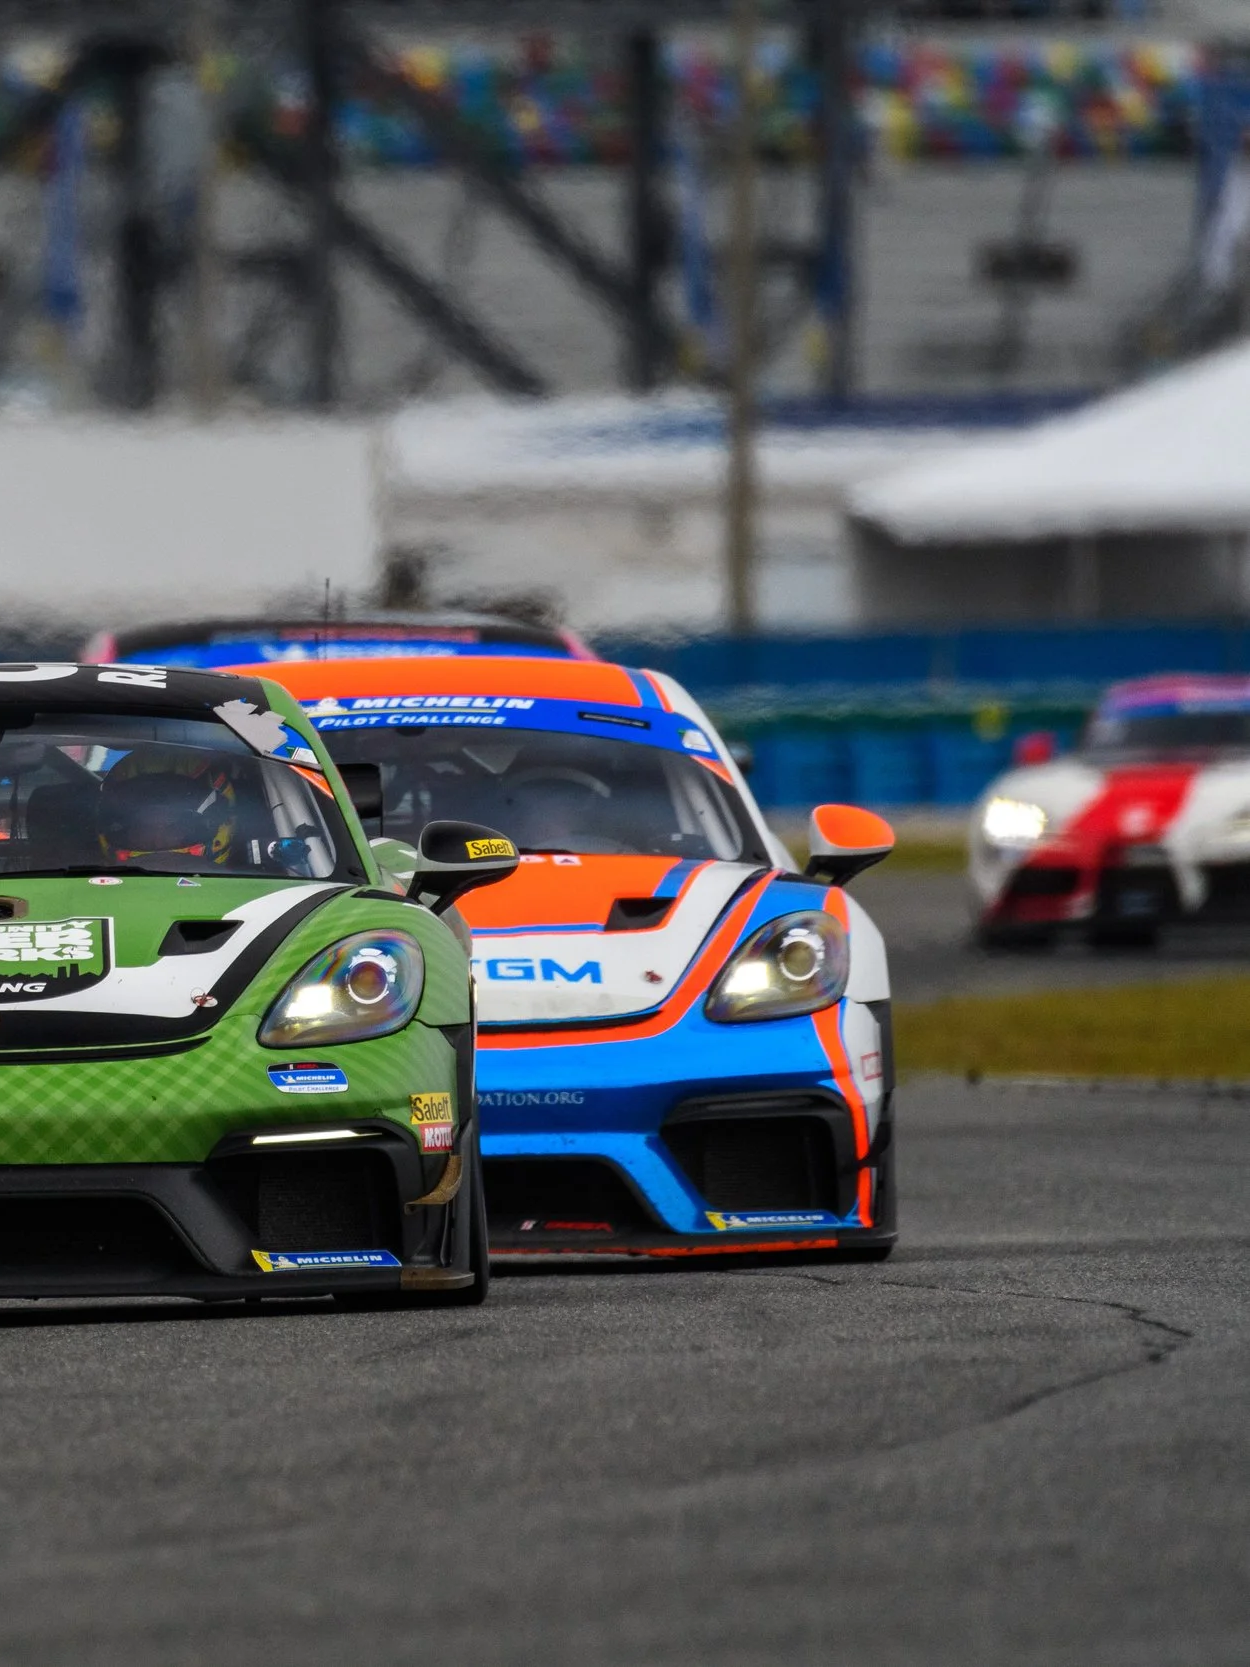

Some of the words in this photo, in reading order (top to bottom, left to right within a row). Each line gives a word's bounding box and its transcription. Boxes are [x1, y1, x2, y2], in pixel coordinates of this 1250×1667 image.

[352, 697, 535, 710] MICHELIN
[317, 717, 381, 729] PILOT
[385, 713, 507, 726] CHALLENGE
[471, 841, 511, 856] Sabelt
[471, 958, 603, 985] GM
[413, 1096, 450, 1122] Sabelt
[424, 1127, 453, 1148] MOTU
[296, 1255, 383, 1265] MICHELIN
